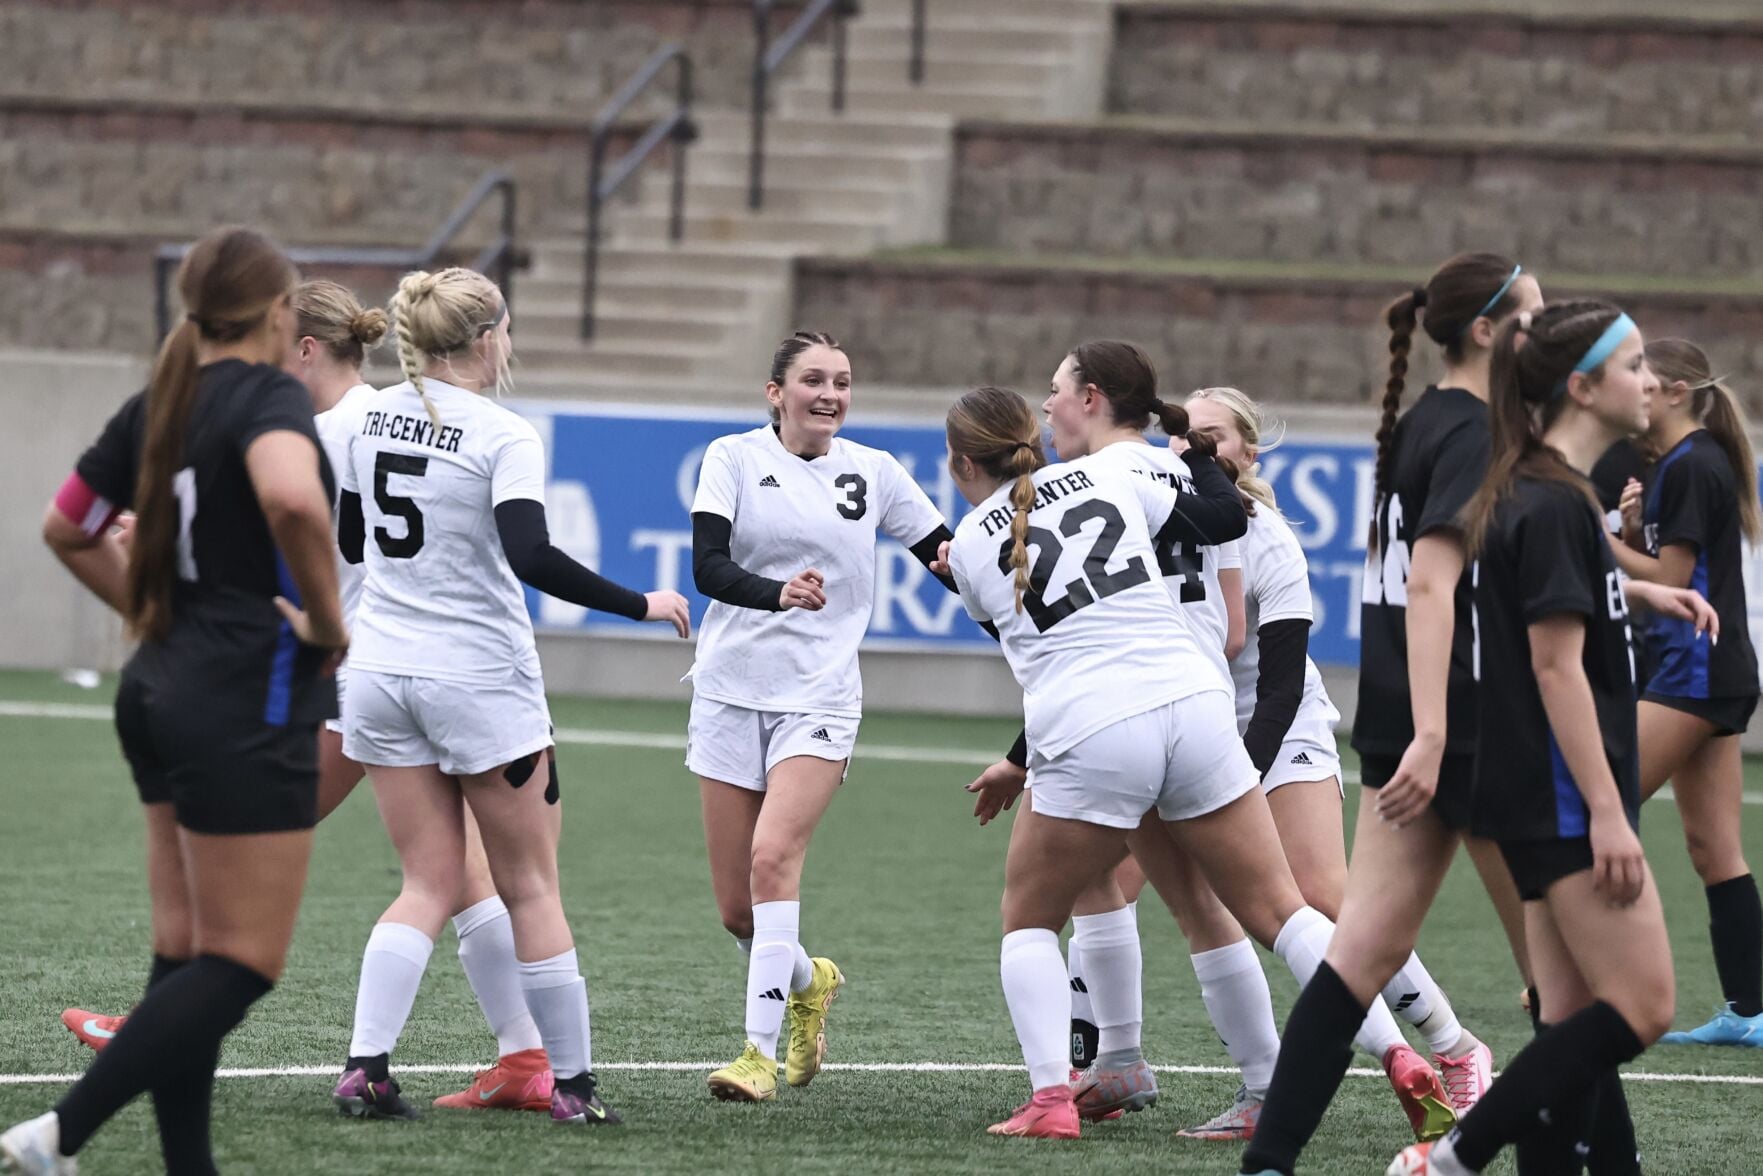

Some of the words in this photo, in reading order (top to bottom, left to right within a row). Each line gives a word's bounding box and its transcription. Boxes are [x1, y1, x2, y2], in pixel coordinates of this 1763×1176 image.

[362, 411, 464, 453] TRI-CENTER
[374, 450, 429, 559] 5
[834, 473, 867, 521] 3
[978, 470, 1095, 537] TRI-ENTER
[997, 498, 1151, 634] 22
